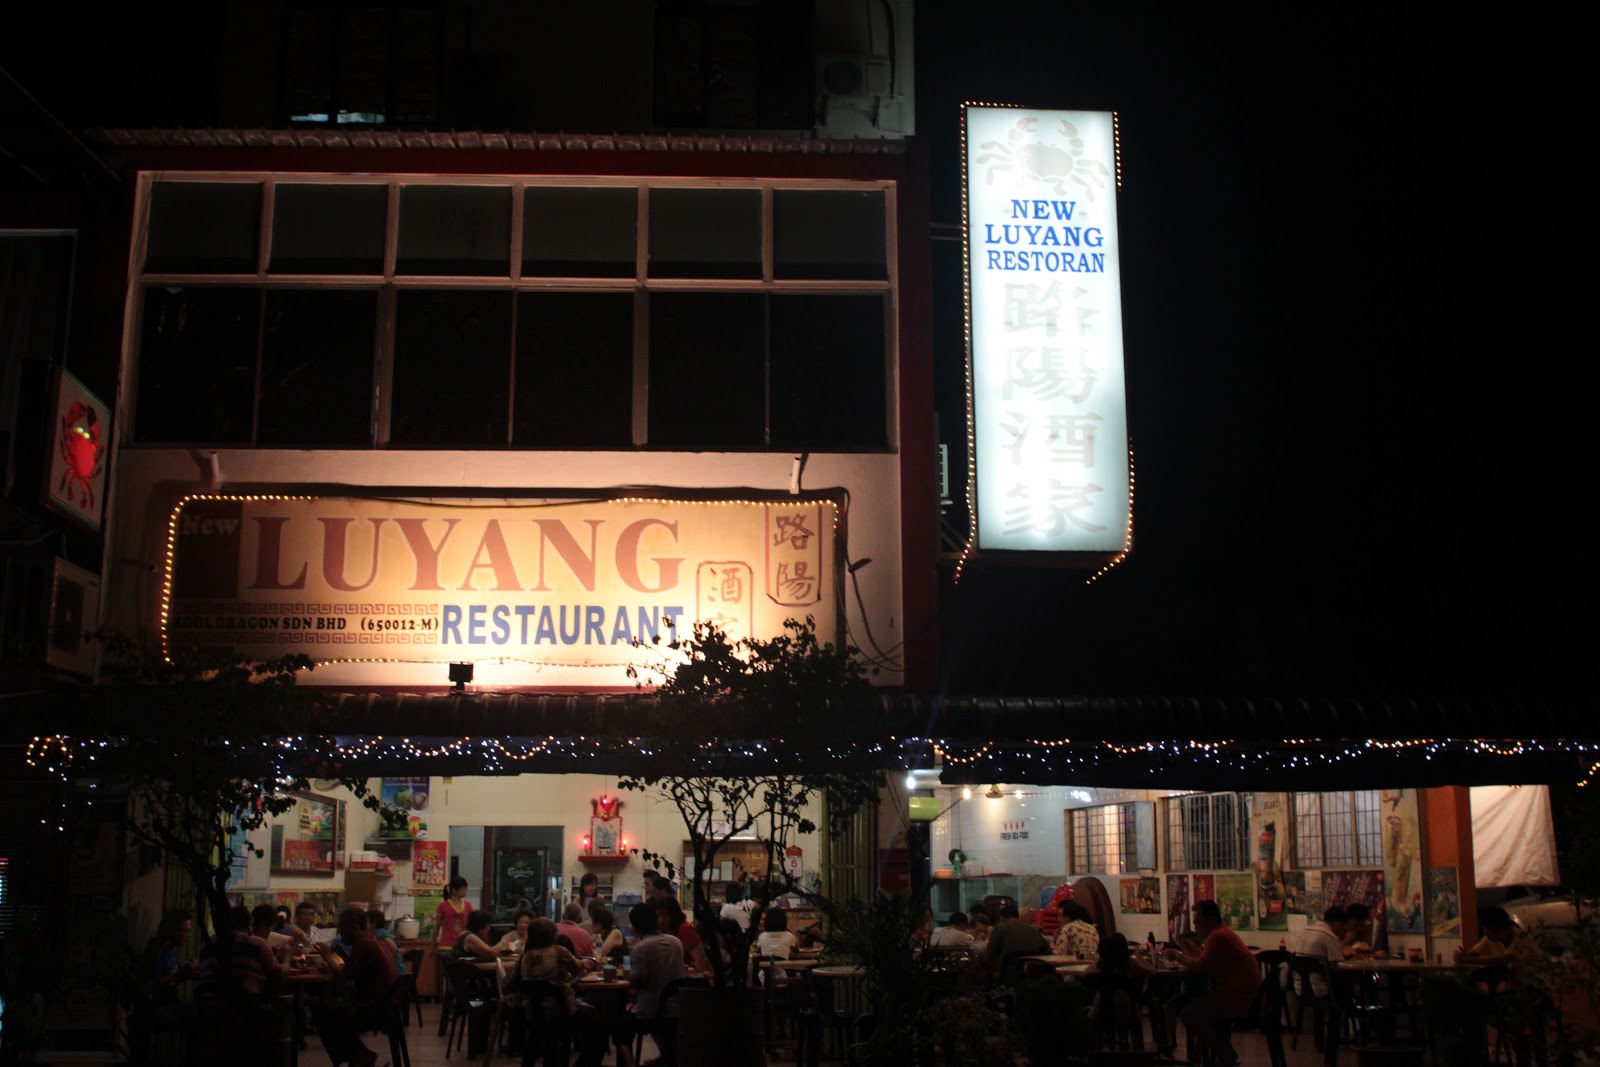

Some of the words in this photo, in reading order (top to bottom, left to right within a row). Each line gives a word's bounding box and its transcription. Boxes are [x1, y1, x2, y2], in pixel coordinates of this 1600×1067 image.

[1011, 199, 1076, 220] NEW
[984, 224, 1104, 247] LUYANG
[986, 249, 1105, 273] RESTORAN
[180, 513, 240, 537] New
[249, 516, 685, 594] LUYANG
[773, 513, 815, 600] 路陽
[216, 616, 279, 630] DRAGON
[282, 616, 312, 630] SDN
[316, 617, 347, 630] BHD
[360, 617, 439, 632] (650012-M)
[441, 604, 684, 646] RESTAURANT
